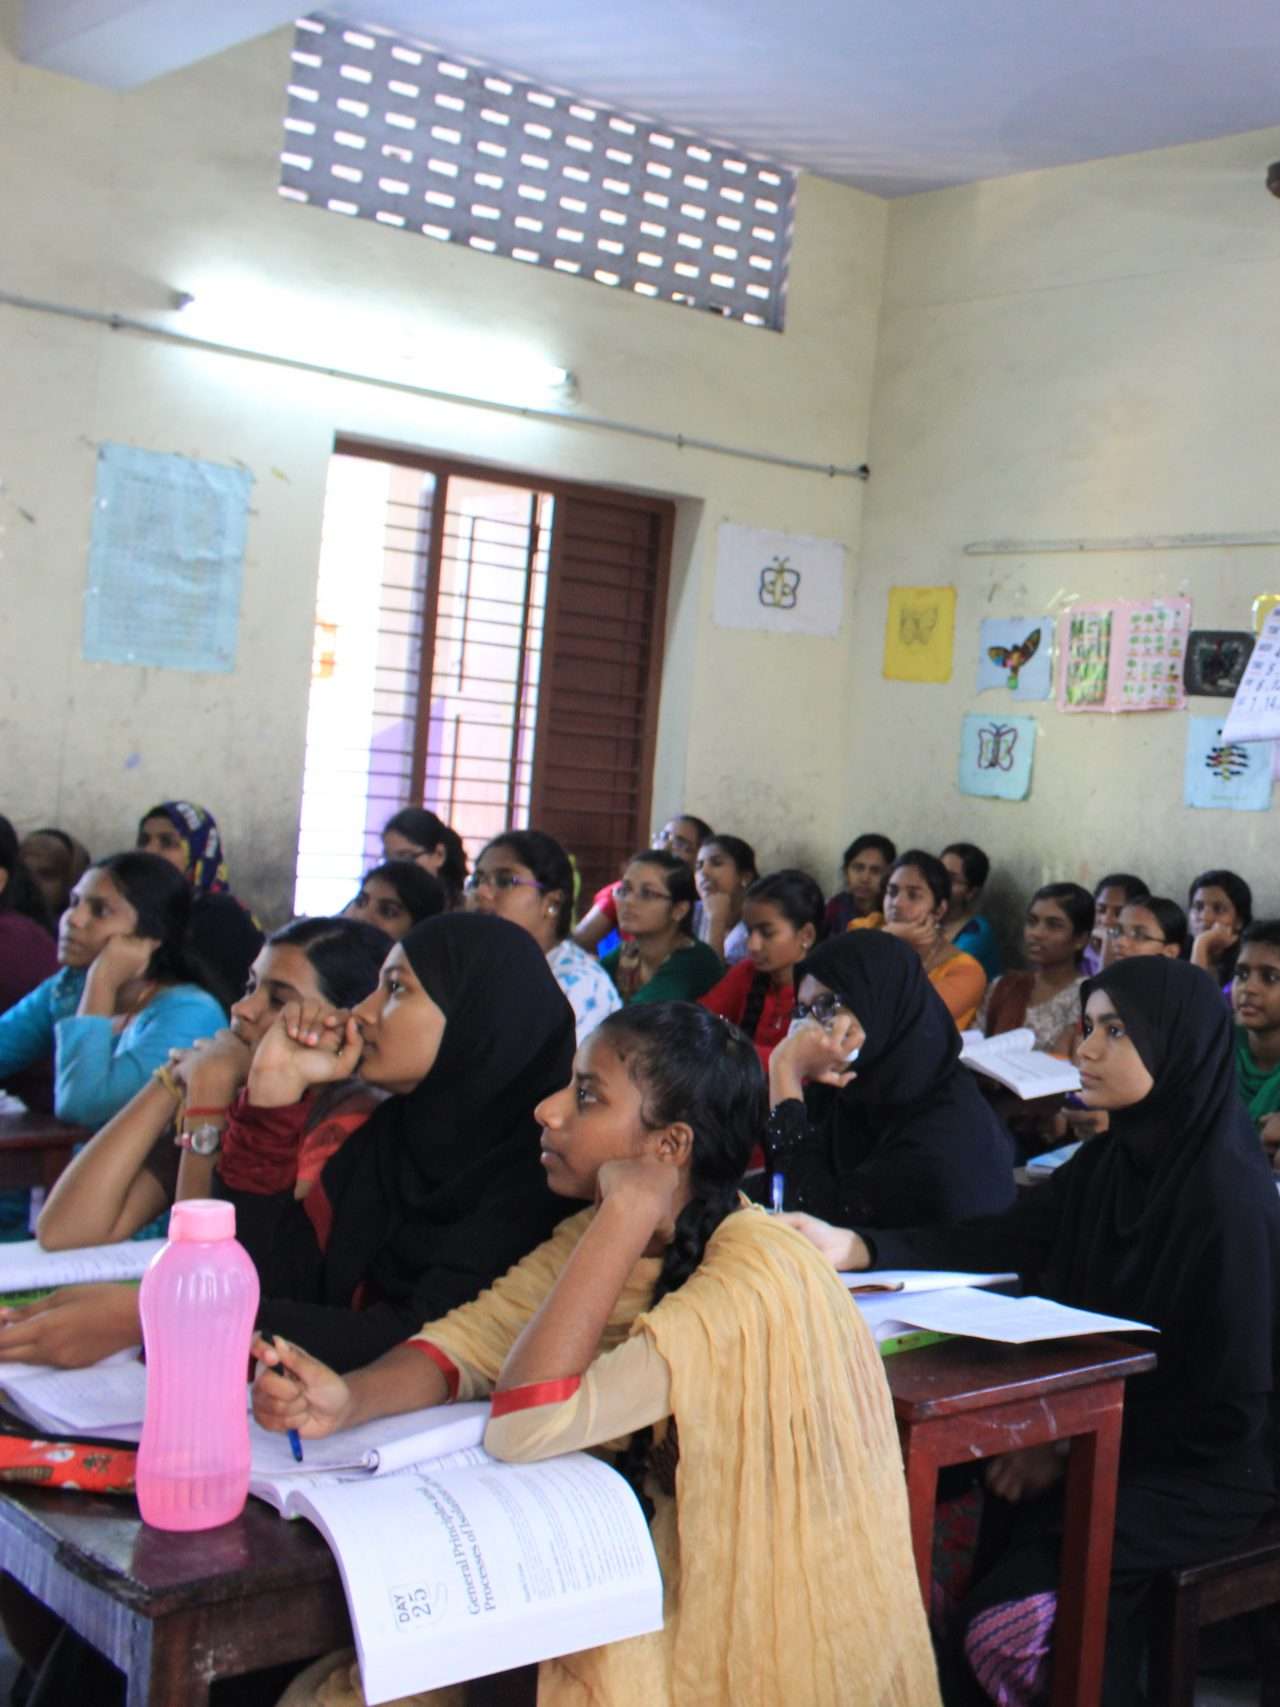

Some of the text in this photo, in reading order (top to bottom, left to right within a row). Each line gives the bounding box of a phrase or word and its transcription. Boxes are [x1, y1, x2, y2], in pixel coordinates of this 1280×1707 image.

[432, 1501, 466, 1558] Principles
[460, 1529, 477, 1542] of
[456, 1560, 481, 1614] General
[472, 1544, 496, 1610] Processes
[393, 1594, 410, 1622] DAY
[408, 1588, 431, 1617] 25
